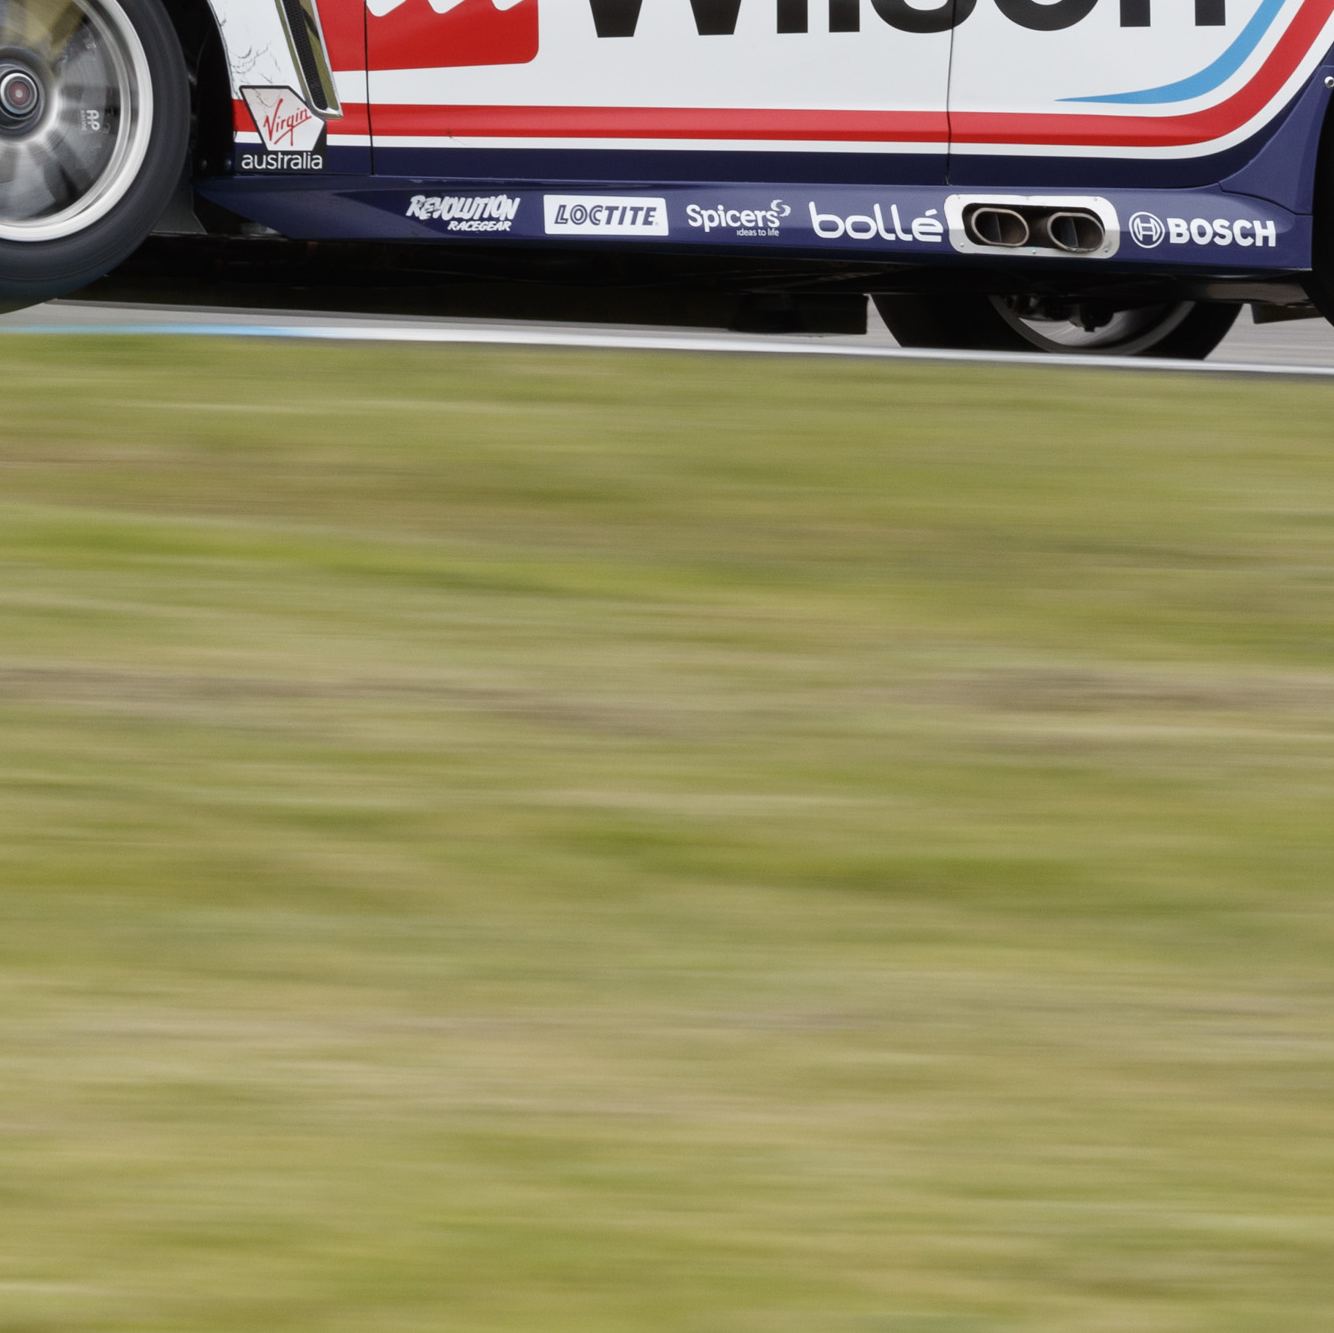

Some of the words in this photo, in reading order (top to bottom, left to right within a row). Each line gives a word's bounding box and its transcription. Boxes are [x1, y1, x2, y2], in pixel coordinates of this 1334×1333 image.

[263, 98, 312, 146] Virgin
[241, 152, 323, 169] australia
[406, 194, 521, 221] REVOLUTION
[554, 204, 656, 226] LOCTITE
[686, 204, 779, 232] Spicers
[447, 219, 511, 232] RACEGEAR
[736, 228, 757, 237] ideas
[758, 229, 766, 237] to
[768, 228, 779, 237] life
[809, 201, 943, 243] bollé
[1169, 217, 1276, 247] BOSCH
